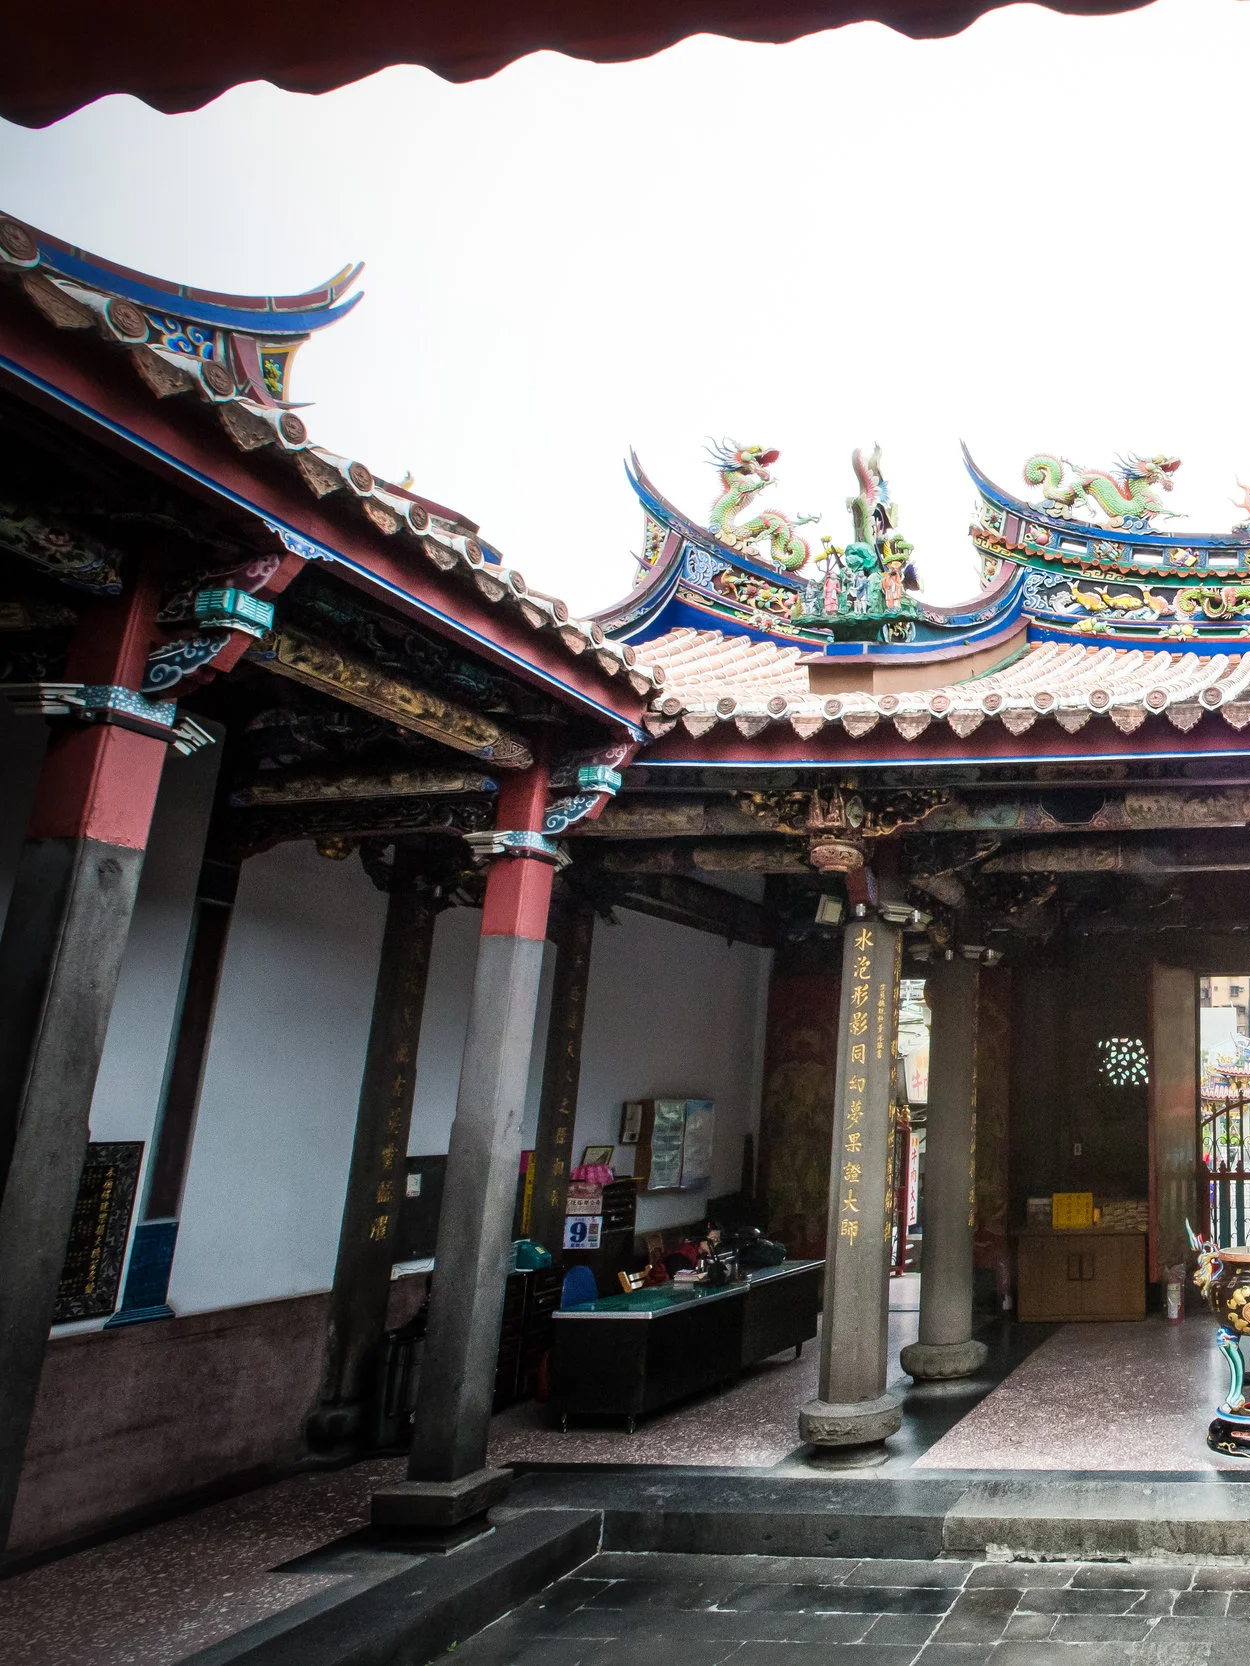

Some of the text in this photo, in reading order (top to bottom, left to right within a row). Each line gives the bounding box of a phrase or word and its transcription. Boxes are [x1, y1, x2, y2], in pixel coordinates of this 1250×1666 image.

[909, 1148, 917, 1221] 牛肉大王
[570, 1222, 587, 1242] 9
